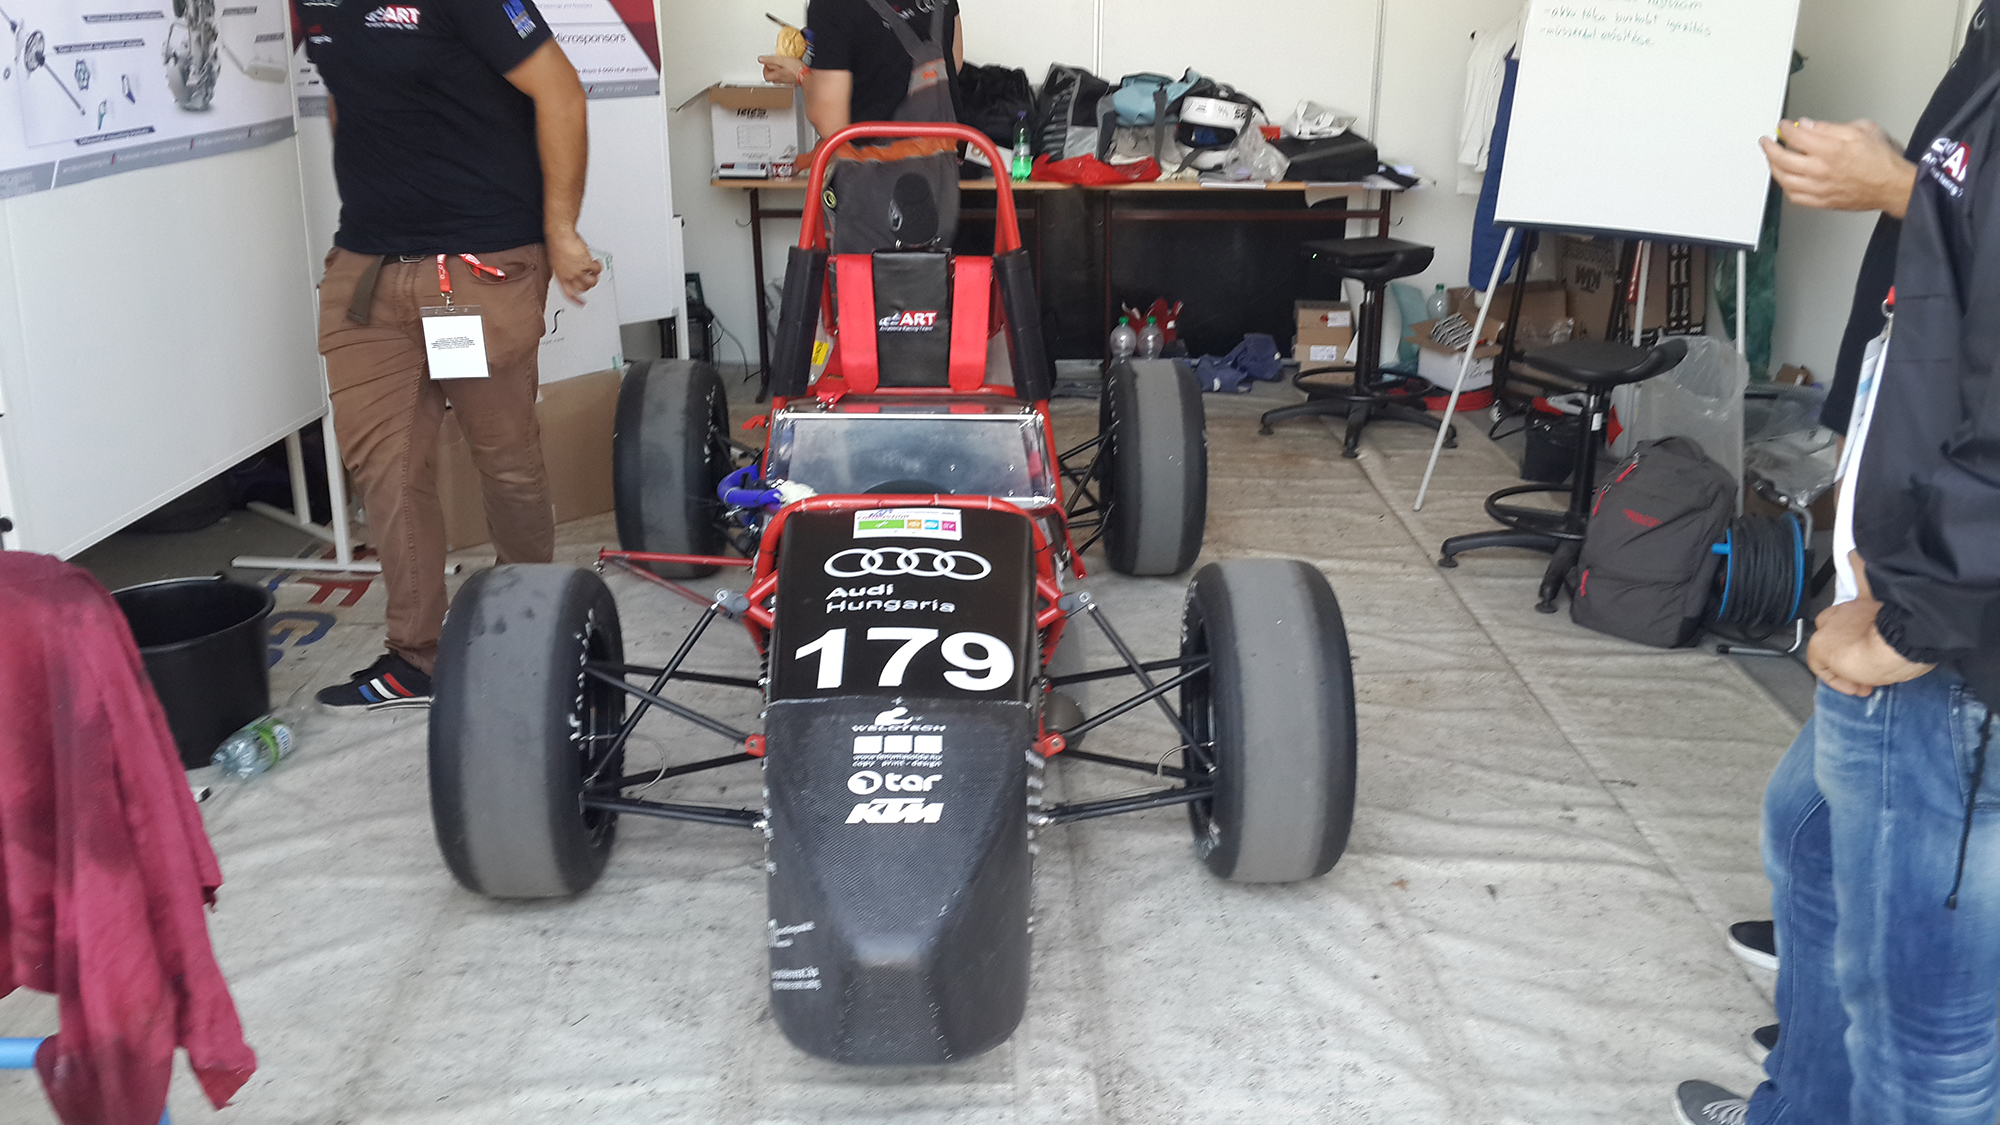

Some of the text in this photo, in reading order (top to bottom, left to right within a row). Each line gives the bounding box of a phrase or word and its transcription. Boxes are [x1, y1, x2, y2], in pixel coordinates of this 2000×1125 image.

[899, 311, 938, 326] ART
[825, 583, 894, 601] Audi
[825, 598, 956, 614] Hungaria
[794, 627, 1015, 691] 179
[884, 772, 943, 792] tar
[844, 797, 945, 824] KTM
